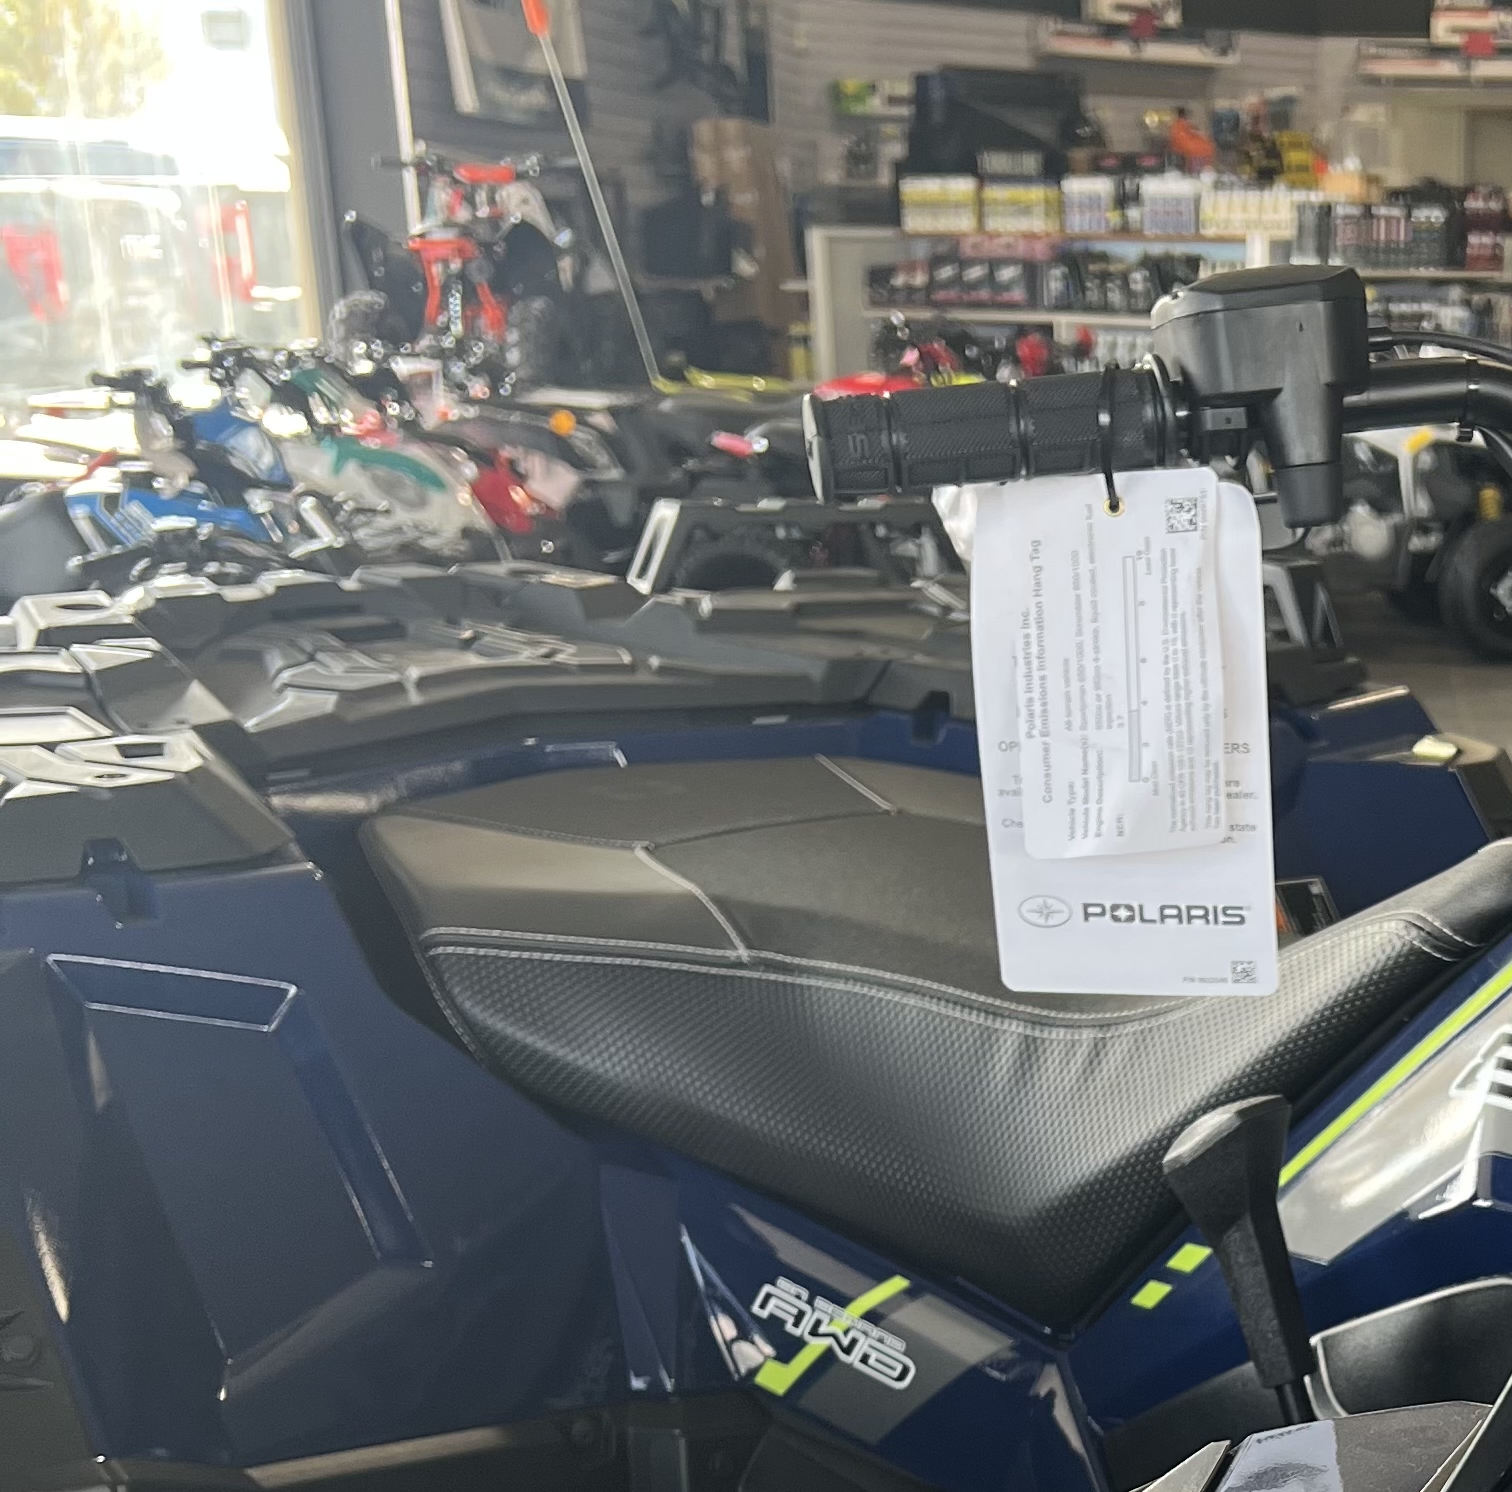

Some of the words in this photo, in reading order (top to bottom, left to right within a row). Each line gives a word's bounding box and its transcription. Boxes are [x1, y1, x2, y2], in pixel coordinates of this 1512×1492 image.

[1028, 539, 1041, 563] Tag
[1032, 601, 1046, 672] Information
[1082, 902, 1247, 926] POLARIS
[752, 1283, 917, 1390] AWD
